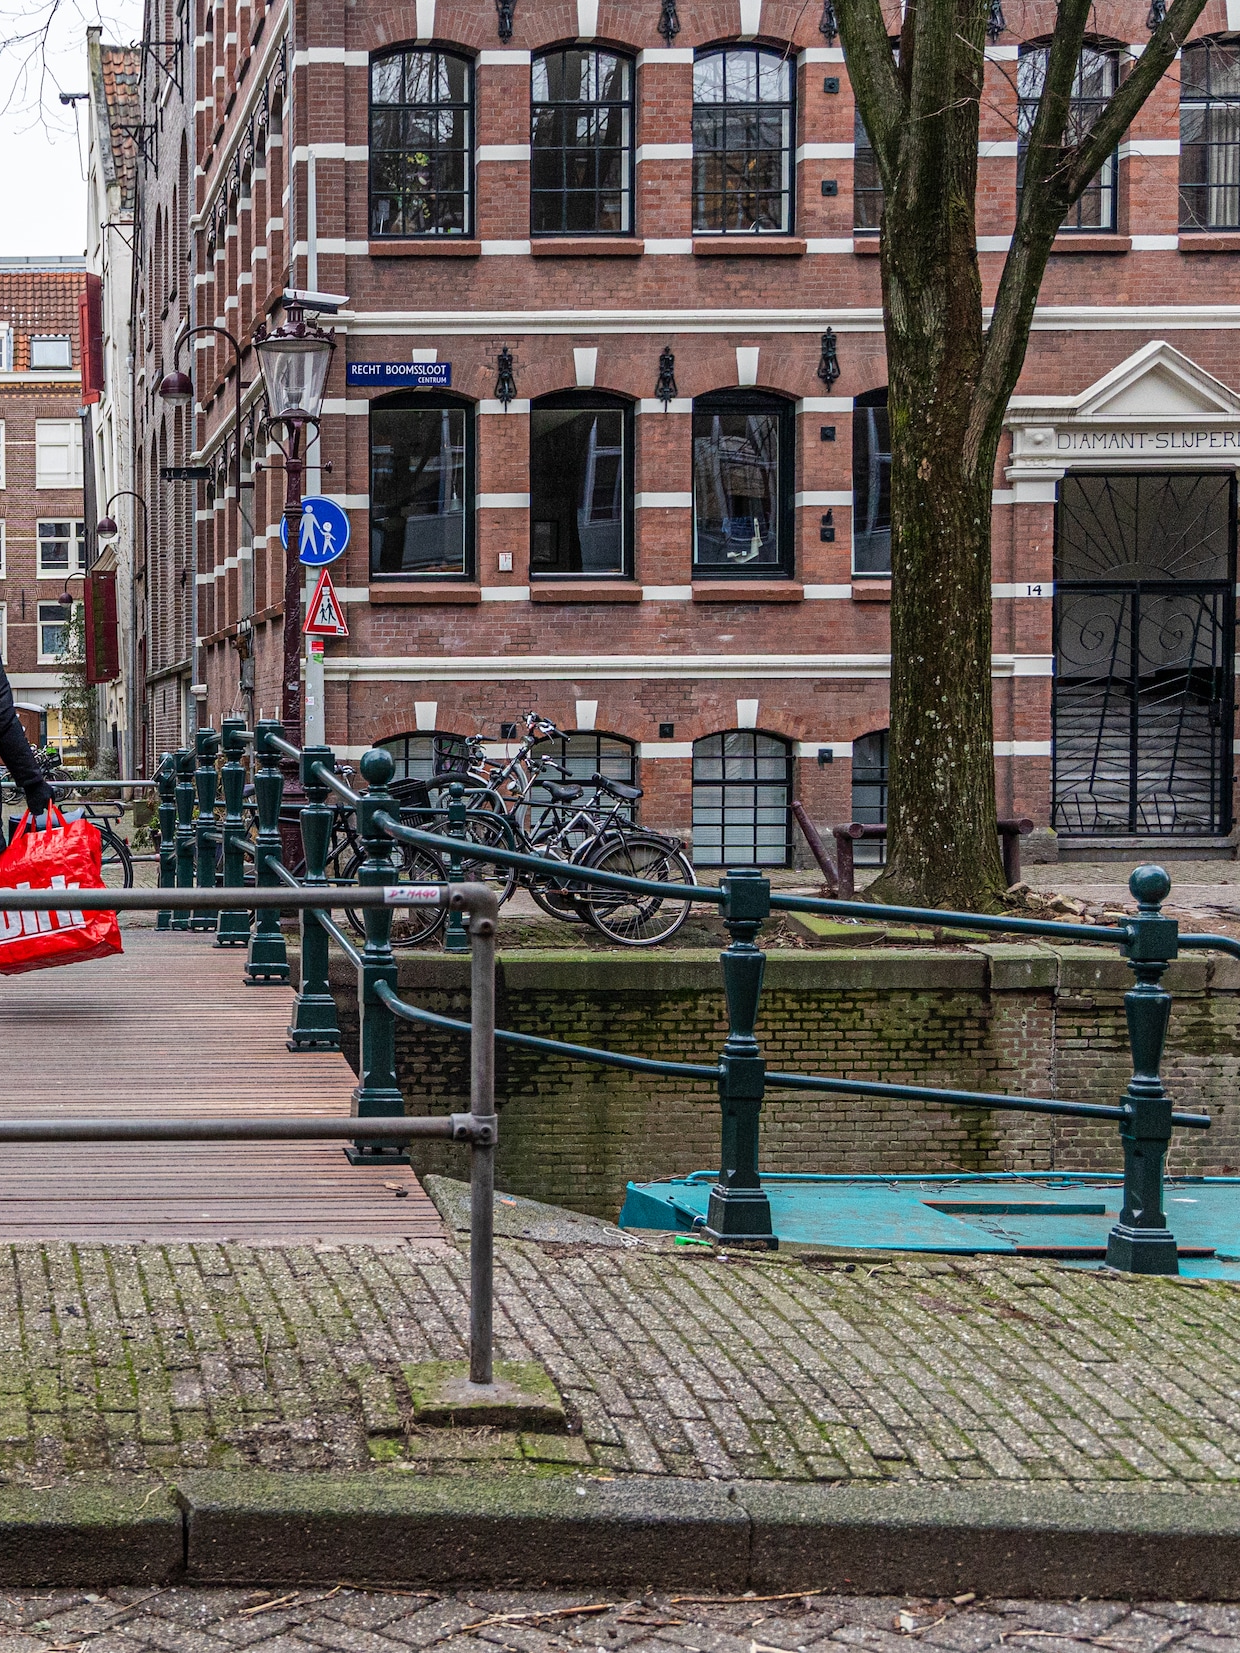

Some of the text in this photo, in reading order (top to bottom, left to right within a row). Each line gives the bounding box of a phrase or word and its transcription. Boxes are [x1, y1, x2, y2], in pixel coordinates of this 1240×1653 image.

[351, 365, 446, 375] RECHT BOOMSSLOOT
[1027, 585, 1042, 596] 14
